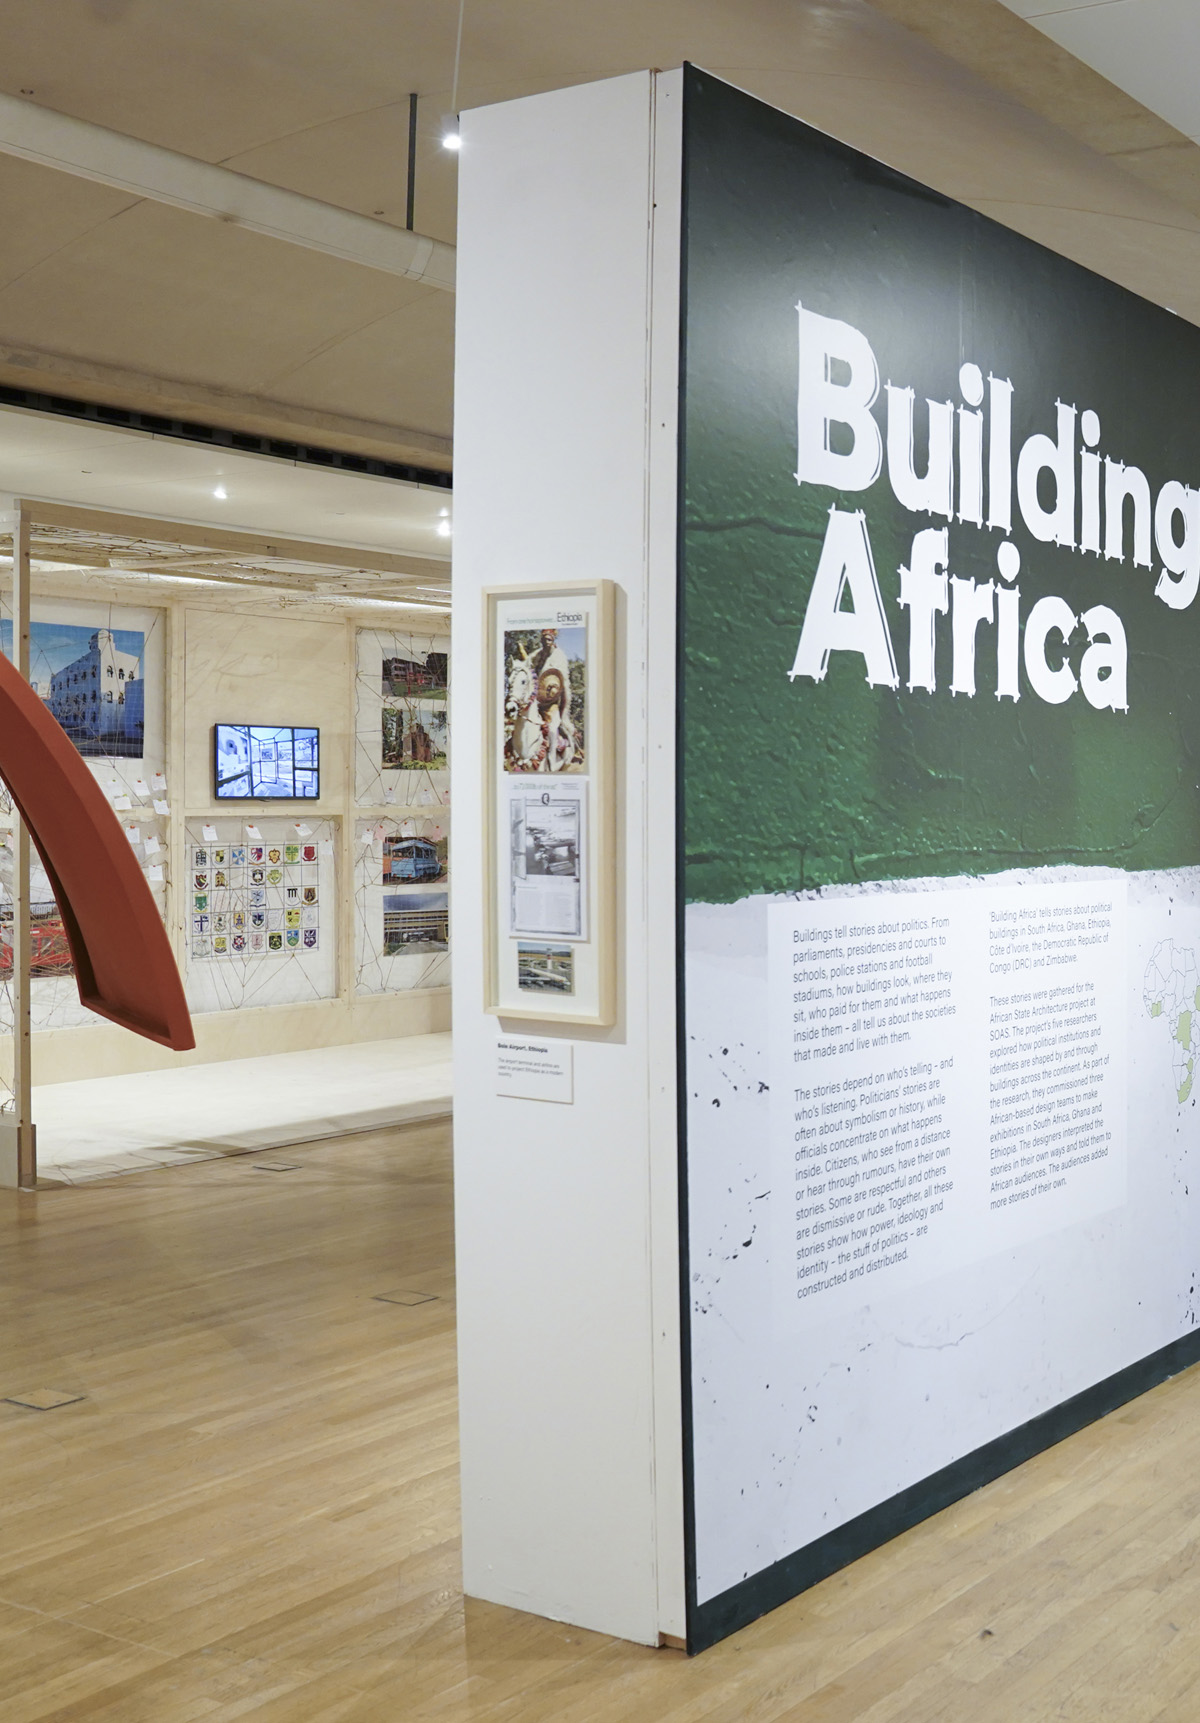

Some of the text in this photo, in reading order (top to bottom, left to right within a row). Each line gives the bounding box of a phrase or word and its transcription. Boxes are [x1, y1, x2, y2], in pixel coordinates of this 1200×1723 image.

[557, 612, 582, 623] Ethiopia
[786, 503, 1130, 715] Africa
[793, 928, 833, 943] Buildings
[834, 925, 847, 939] tell
[849, 923, 876, 937] stories
[877, 922, 900, 934] about
[931, 916, 950, 928] From
[847, 940, 897, 959] presidencies
[898, 937, 913, 951] and
[914, 936, 938, 949] courts
[938, 936, 947, 945] to
[830, 964, 855, 981] police
[856, 960, 888, 974] stations
[889, 957, 904, 970] and
[905, 954, 933, 967] football
[836, 984, 854, 996] how
[856, 978, 892, 994] buildings
[913, 972, 936, 984] where
[936, 970, 953, 983] they
[808, 1006, 827, 1020] who
[829, 1002, 847, 1020] paid
[848, 1001, 860, 1013] for
[861, 999, 882, 1012] them
[883, 994, 899, 1008] and
[900, 992, 919, 1005] what
[920, 988, 952, 1002] happens
[794, 1004, 957, 1042] inside them all tell us about the societies
[793, 1049, 811, 1062] that
[813, 1043, 837, 1058] made
[838, 1039, 855, 1054] and
[856, 1037, 870, 1050] live
[871, 1033, 889, 1047] with
[794, 1088, 811, 1101] The
[812, 1082, 841, 1098] stories
[842, 1073, 873, 1092] depend
[874, 1073, 885, 1084] on
[909, 1063, 932, 1076] telling
[939, 1056, 954, 1069] and
[902, 1081, 928, 1096] stories
[928, 1079, 941, 1090] are
[794, 1127, 817, 1142] often
[818, 1120, 844, 1136] about
[844, 1110, 888, 1131] symbolism
[888, 1107, 898, 1118] or
[926, 1093, 946, 1108] while
[990, 1089, 1098, 1125] African-based design teams to make
[794, 1114, 942, 1161] officials concentrate on what happens
[861, 1148, 879, 1162] who
[880, 1145, 894, 1157] see
[895, 1140, 913, 1152] from
[914, 1138, 919, 1148] a
[920, 1129, 951, 1145] distance
[795, 1189, 806, 1201] or
[806, 1183, 827, 1197] hear
[828, 1171, 860, 1191] through
[898, 1157, 916, 1170] have
[917, 1150, 934, 1164] their
[935, 1147, 951, 1159] own
[828, 1194, 853, 1210] Some
[853, 1190, 867, 1202] are
[868, 1175, 907, 1198] respectful
[908, 1170, 922, 1186] and
[923, 1165, 947, 1180] others
[990, 1178, 1013, 1193] African
[1048, 1163, 1060, 1174] The
[1060, 1154, 1090, 1170] audiences
[1090, 1146, 1108, 1161] added
[796, 1227, 811, 1240] are
[812, 1212, 856, 1235] dismissive
[856, 1209, 866, 1220] or
[923, 1184, 933, 1198] all
[933, 1181, 954, 1195] these
[990, 1197, 1008, 1210] more
[1008, 1189, 1030, 1204] stories
[1030, 1184, 1038, 1196] of
[1037, 1180, 1052, 1194] their
[796, 1242, 826, 1260] stories
[827, 1234, 850, 1250] show
[851, 1227, 868, 1241] how
[897, 1207, 929, 1225] ideology
[929, 1199, 944, 1214] and
[797, 1225, 929, 1279] identity the stuff of politics are
[797, 1269, 847, 1298] constructed
[849, 1263, 865, 1280] and
